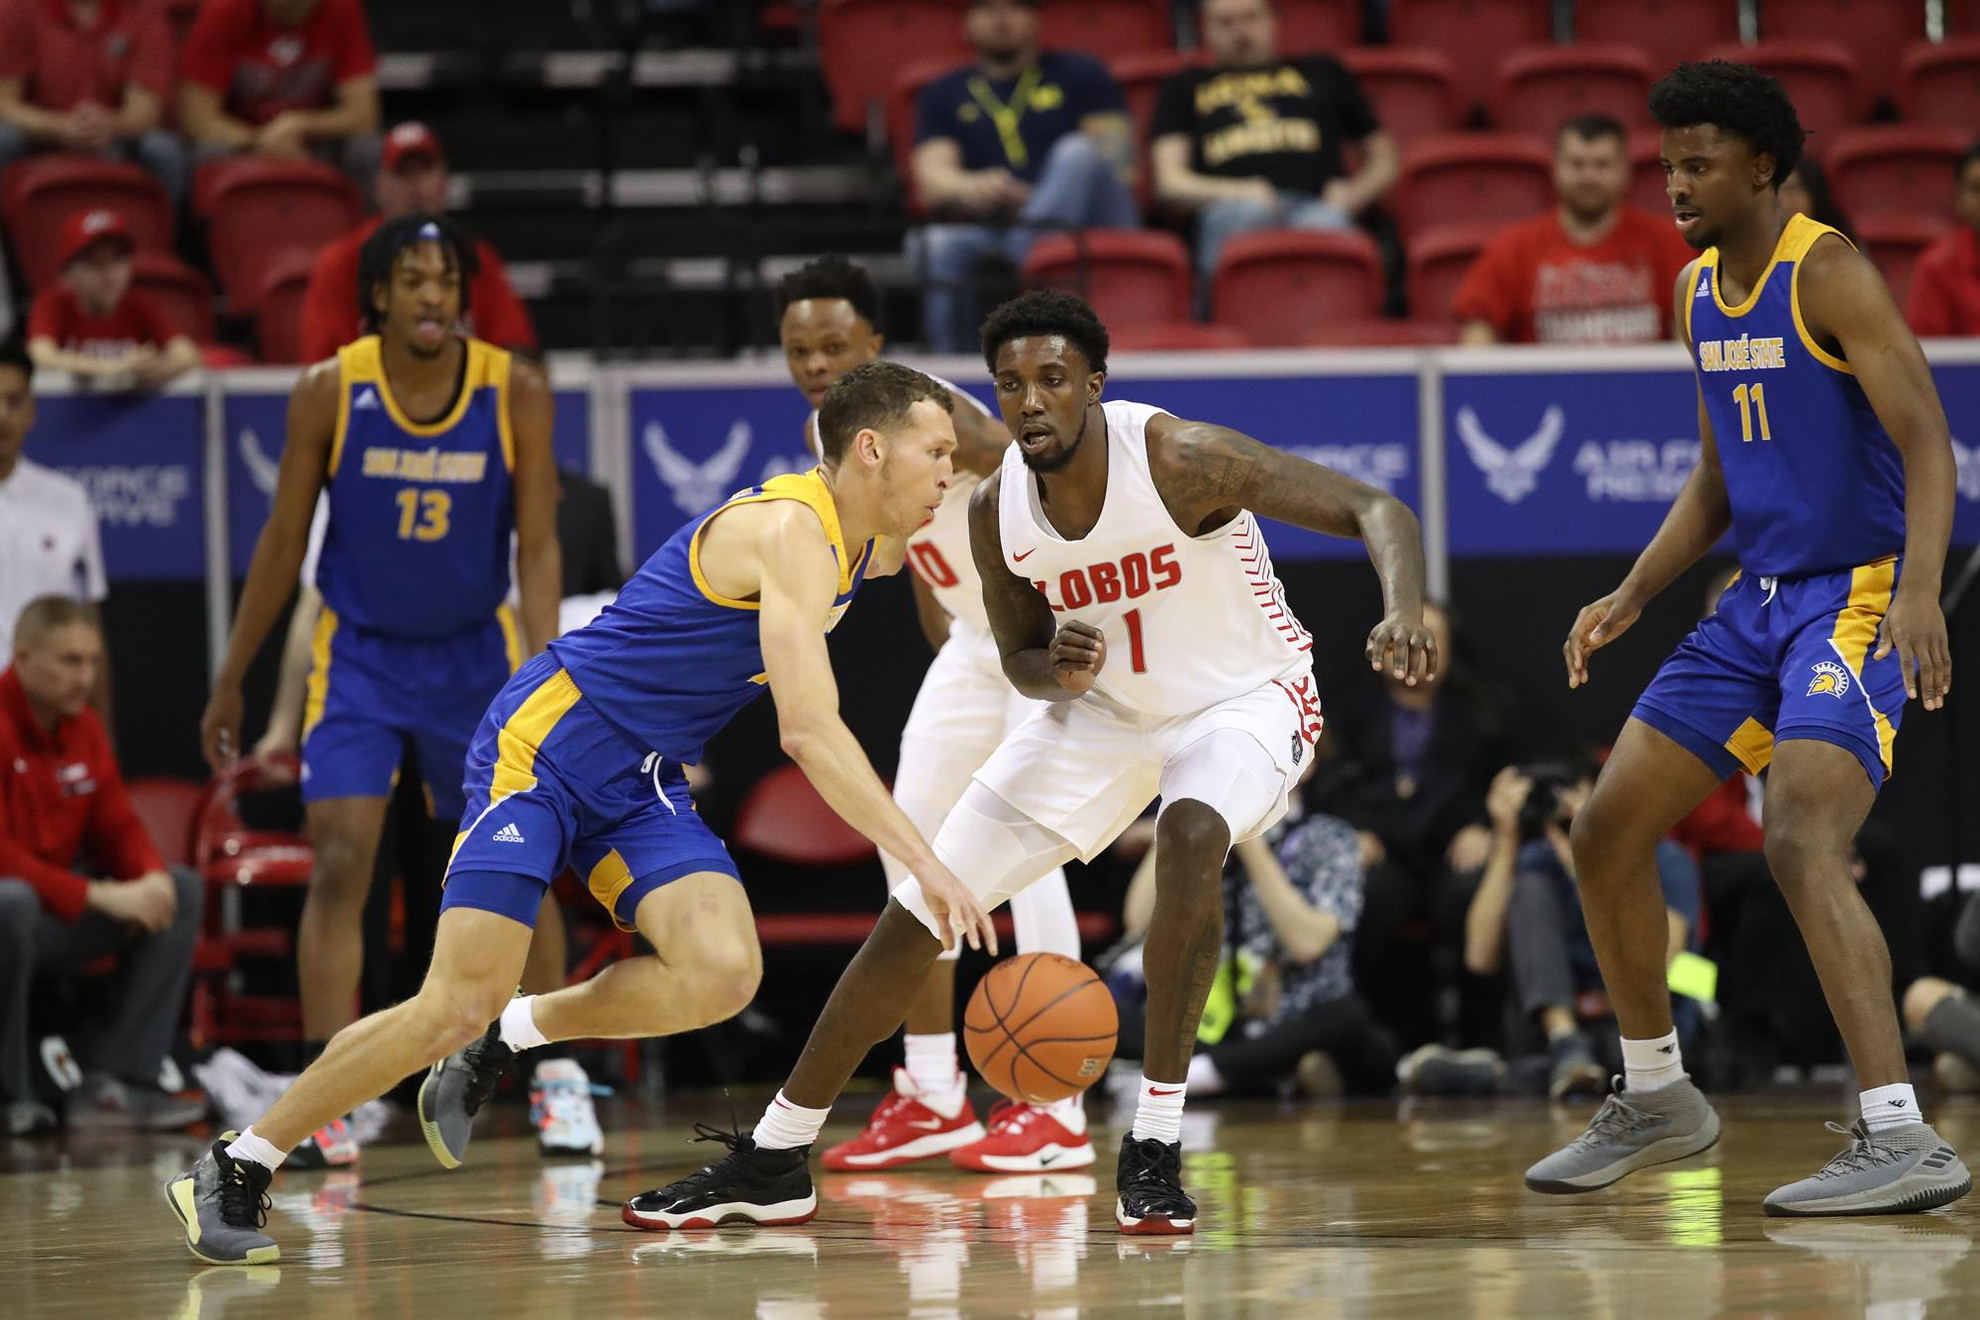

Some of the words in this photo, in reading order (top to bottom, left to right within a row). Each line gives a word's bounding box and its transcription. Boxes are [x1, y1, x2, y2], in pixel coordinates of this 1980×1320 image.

[1699, 341, 1723, 372] SAN
[1750, 337, 1787, 369] STATE
[1732, 383, 1771, 442] 11
[396, 487, 452, 542] 13
[1122, 607, 1148, 675] 1
[492, 834, 525, 844] adidas
